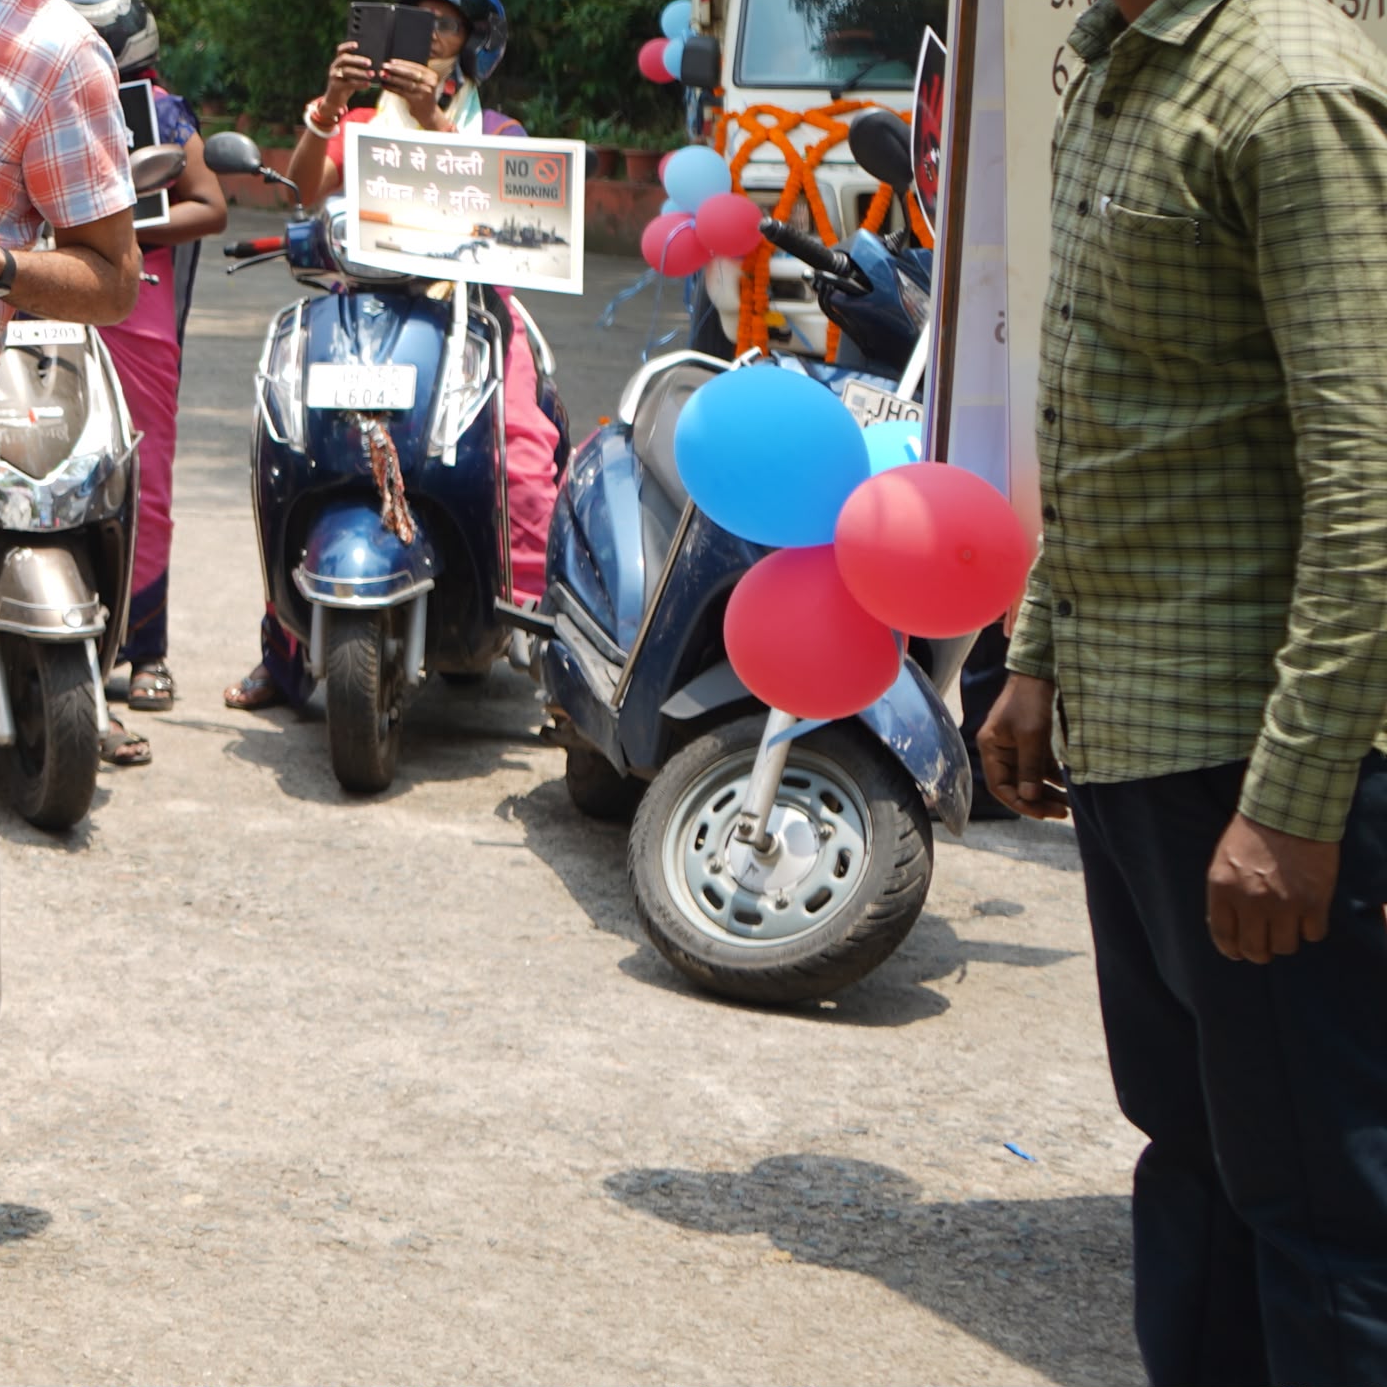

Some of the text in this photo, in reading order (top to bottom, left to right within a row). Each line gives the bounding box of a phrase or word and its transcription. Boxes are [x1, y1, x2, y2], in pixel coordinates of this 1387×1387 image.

[371, 143, 485, 176] नशे से दोस्ती
[505, 159, 529, 178] NO
[365, 176, 415, 202] जीवन
[423, 182, 440, 207] से
[505, 183, 560, 200] SMOKING
